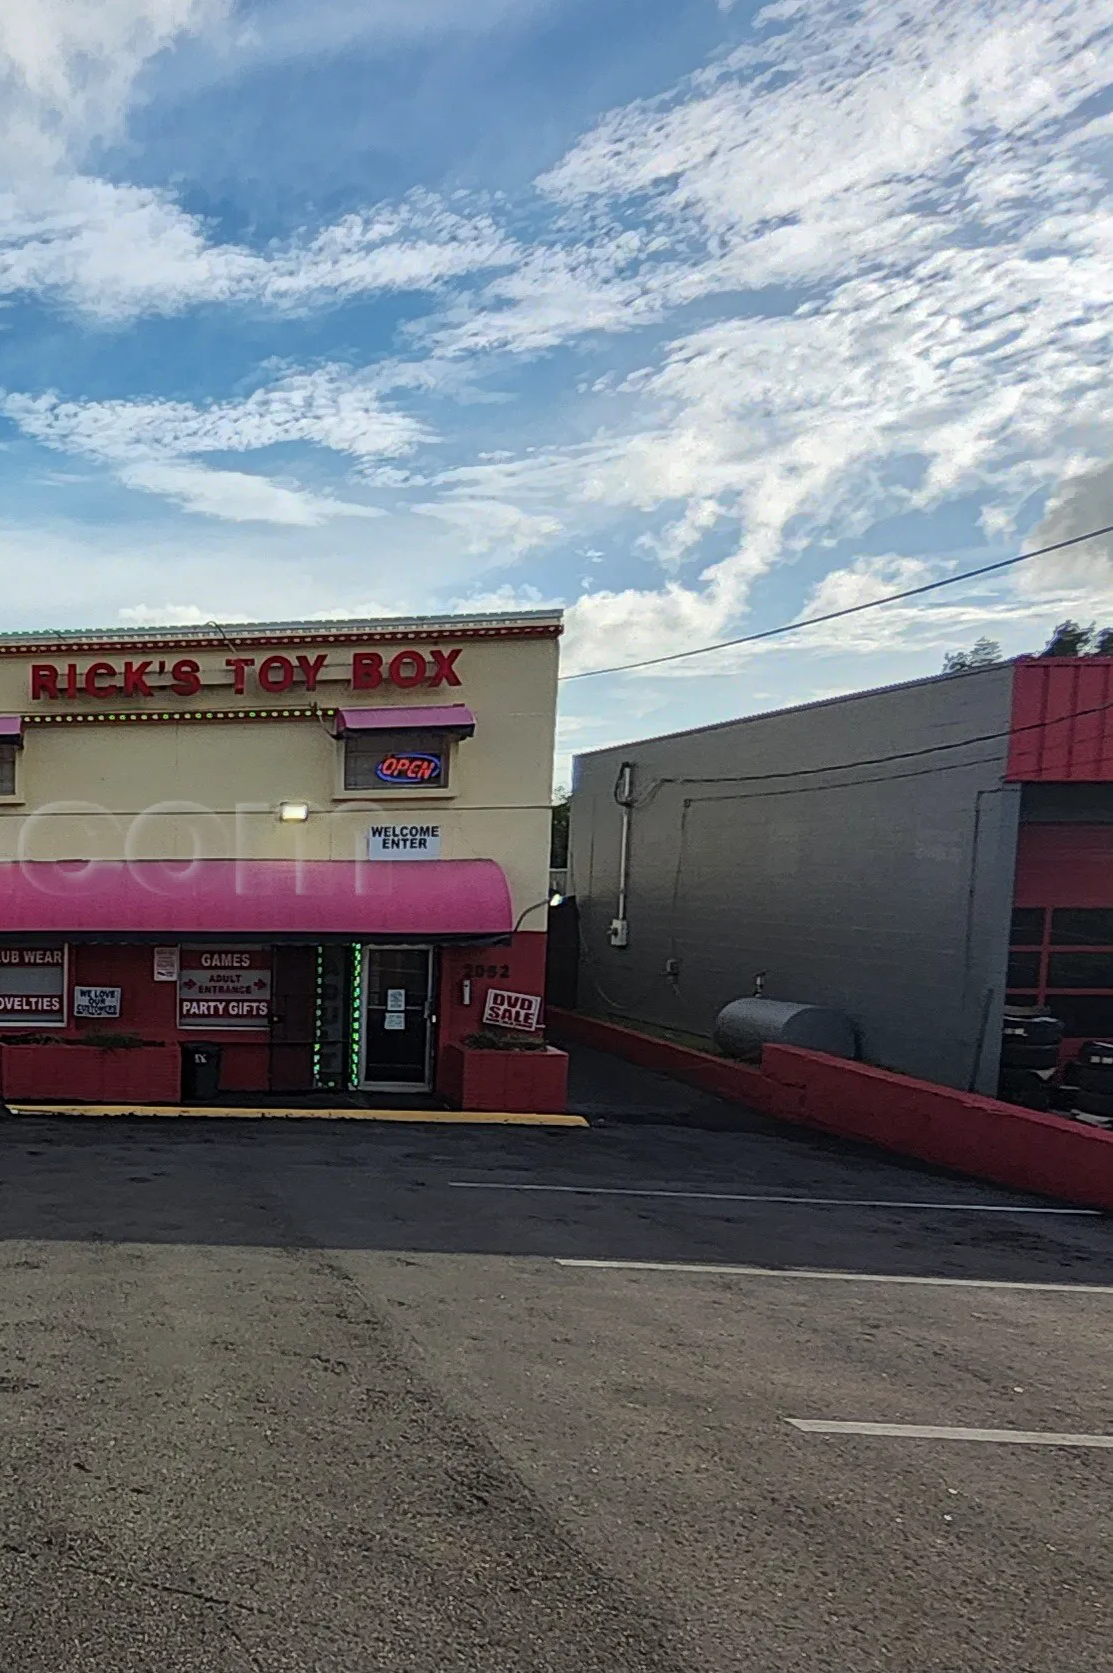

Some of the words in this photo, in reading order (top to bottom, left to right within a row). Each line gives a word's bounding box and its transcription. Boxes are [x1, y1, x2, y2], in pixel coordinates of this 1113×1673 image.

[31, 659, 201, 700] RICK'S
[225, 653, 328, 695] TOY
[351, 648, 463, 691] BOX
[382, 758, 436, 779] OPEN
[371, 826, 439, 838] WELCOME
[382, 838, 427, 850] ENTER
[23, 951, 63, 964] WEAR
[201, 953, 251, 967] GAMES
[208, 974, 243, 983] ADULT
[94, 990, 115, 998] LOVE
[182, 1001, 226, 1015] PARTY
[228, 1001, 268, 1015] GIFTS
[492, 993, 533, 1011] DVD
[489, 1006, 533, 1024] SALE
